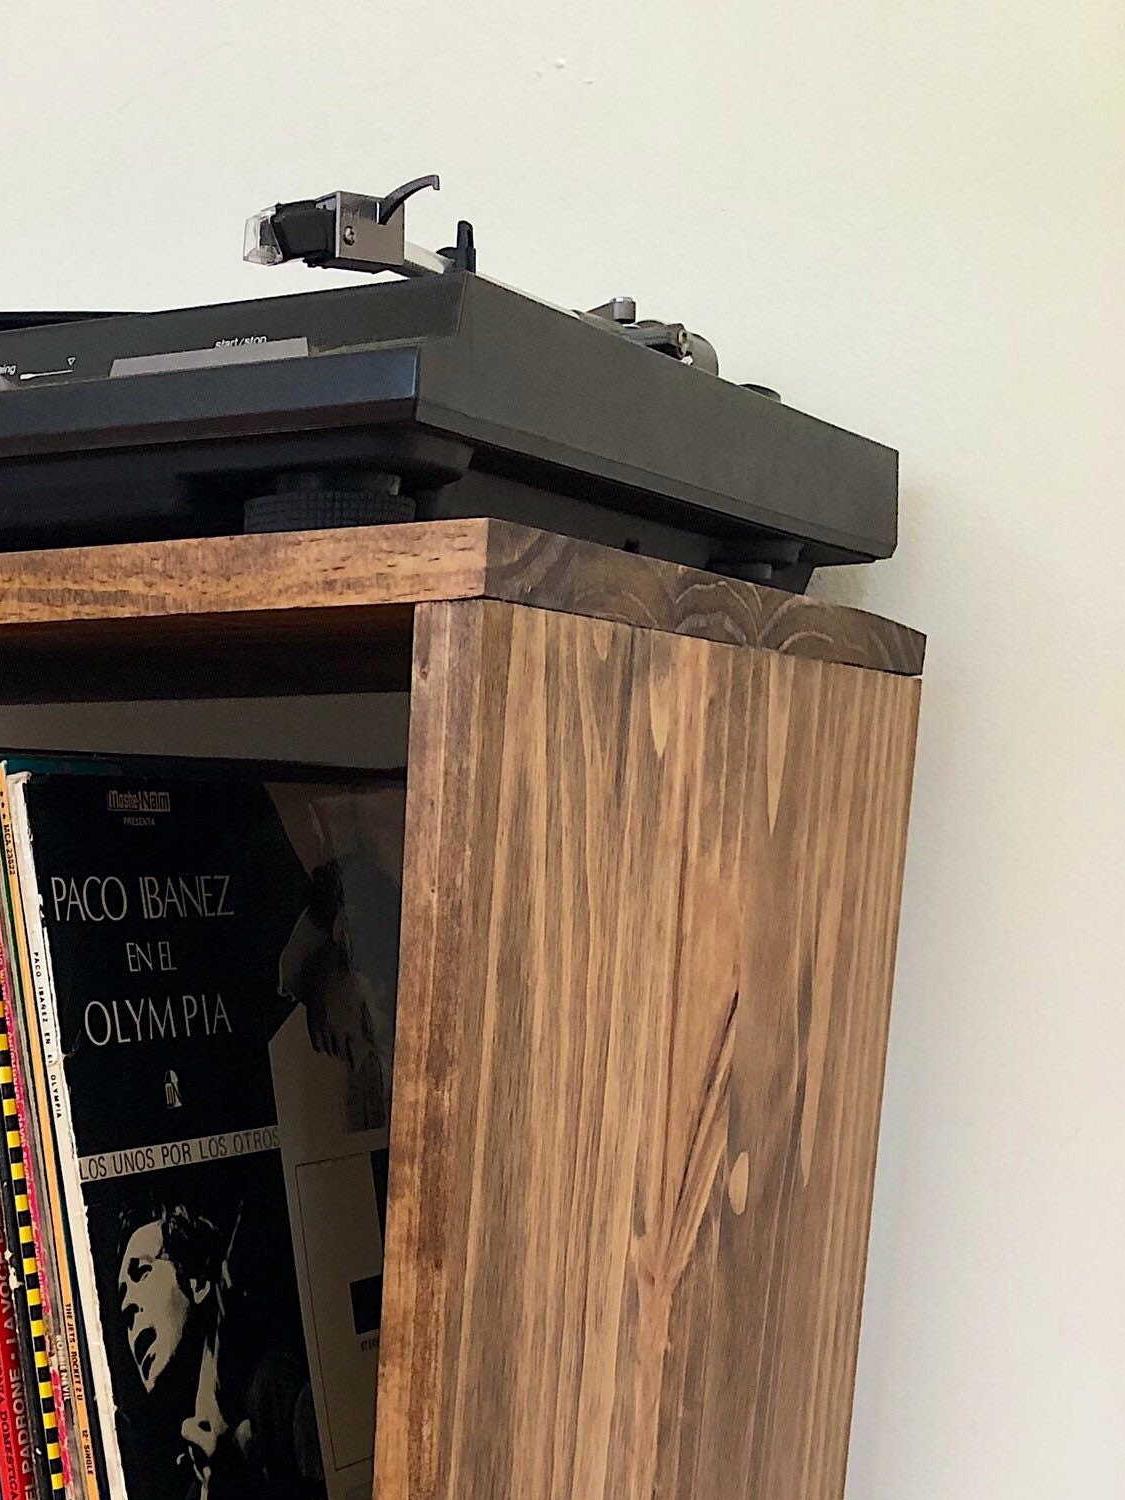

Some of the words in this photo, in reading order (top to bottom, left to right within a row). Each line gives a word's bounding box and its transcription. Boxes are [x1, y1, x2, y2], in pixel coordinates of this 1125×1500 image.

[123, 816, 156, 827] PRESENTA
[51, 876, 127, 921] PACO
[139, 875, 235, 920] IBANEZ
[33, 952, 43, 978] PACO
[127, 941, 153, 972] EN
[160, 941, 177, 972] EL
[37, 986, 49, 1023] IBAÑEZ
[84, 993, 233, 1046] OLYMPIA
[44, 1032, 52, 1044] EN
[49, 1074, 62, 1119] OLYMPIA
[79, 1156, 107, 1181] LOS
[114, 1150, 156, 1175] UNOS
[161, 1145, 192, 1166] POR
[198, 1138, 228, 1163] LOS
[233, 1128, 281, 1155] OTROS
[64, 1303, 73, 1320] THE
[66, 1322, 77, 1343] JETS
[70, 1350, 82, 1385] ROCKET
[10, 1369, 35, 1474] PADRONE
[83, 1444, 95, 1475] SINGLE
